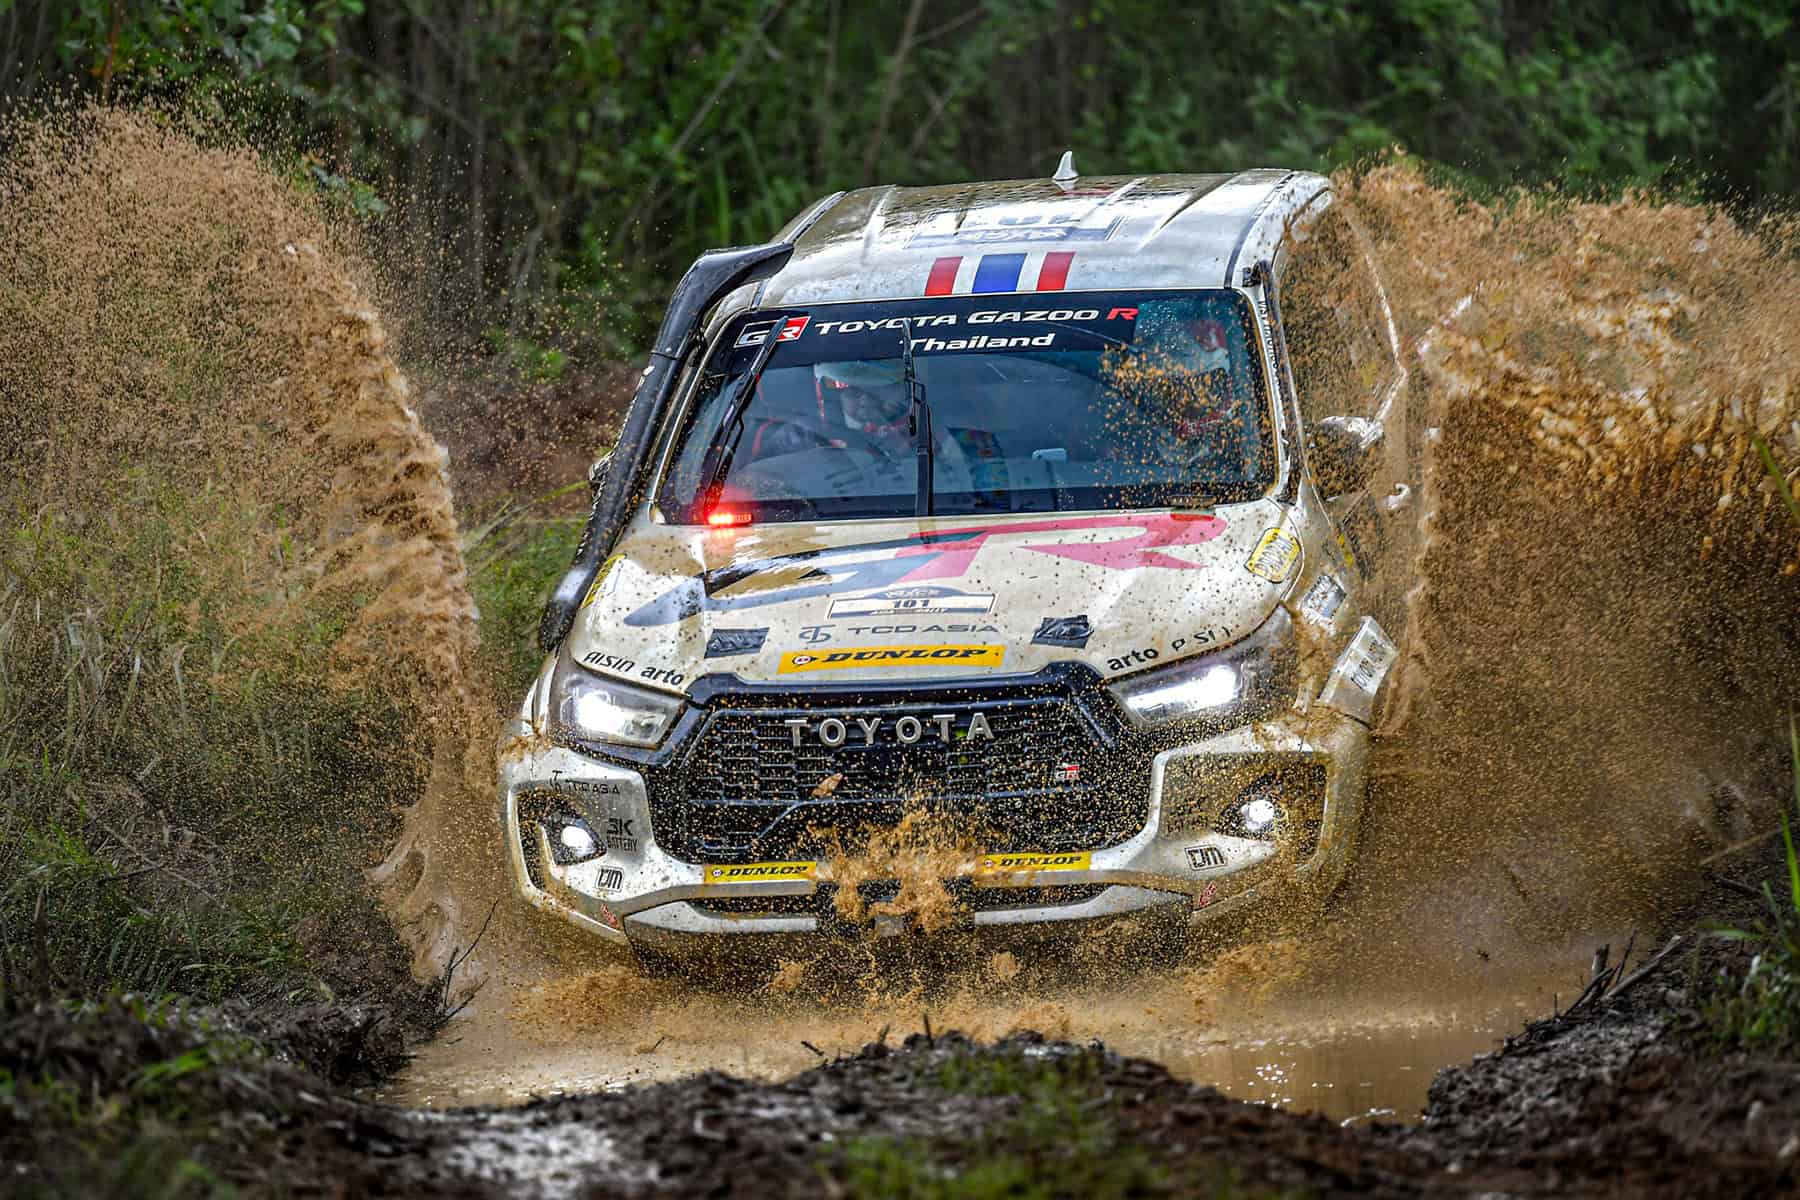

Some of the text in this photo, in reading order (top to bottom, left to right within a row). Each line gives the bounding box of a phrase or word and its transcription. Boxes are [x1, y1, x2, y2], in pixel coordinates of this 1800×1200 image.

[968, 309, 1100, 324] GAZOO
[893, 599, 930, 609] 101
[921, 623, 999, 633] ASIA
[822, 648, 988, 663] DUNLOP
[1106, 647, 1159, 671] arto
[640, 666, 684, 686] arto
[784, 711, 995, 748] TOYOTA
[727, 865, 808, 877] DUNLOP
